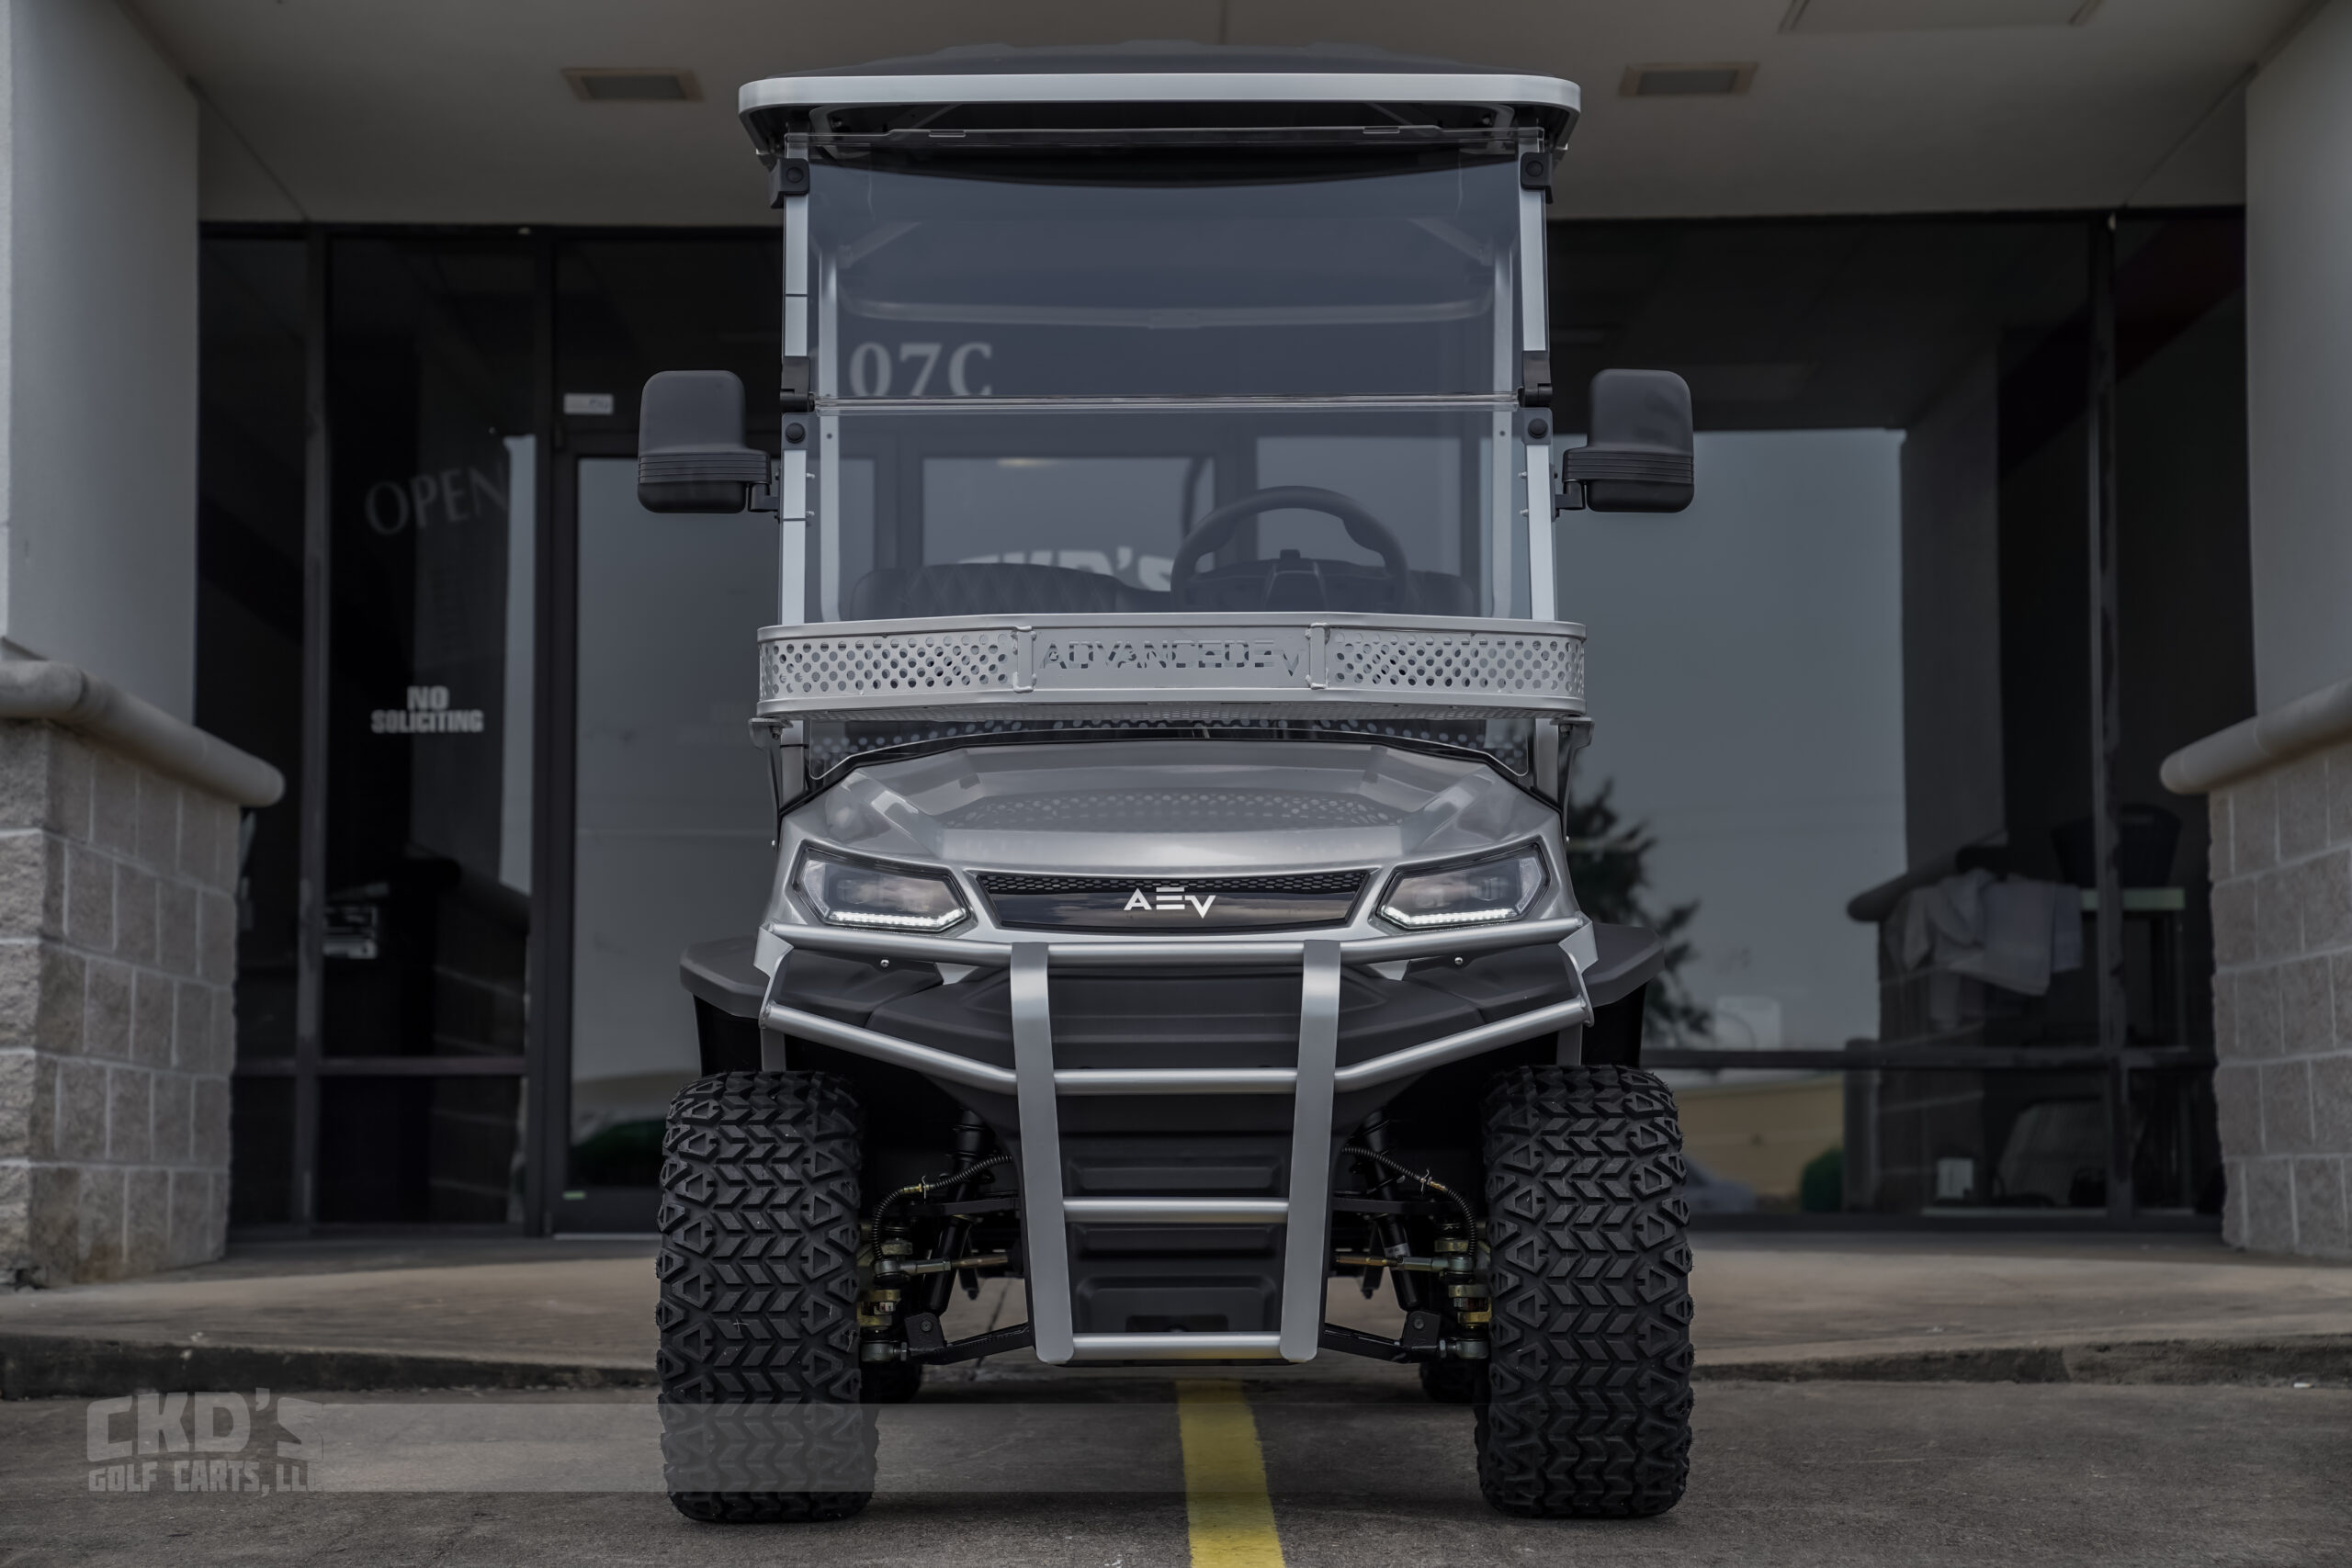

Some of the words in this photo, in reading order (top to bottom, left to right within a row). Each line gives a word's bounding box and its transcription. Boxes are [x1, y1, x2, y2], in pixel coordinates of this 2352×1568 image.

[809, 341, 993, 396] 07C
[365, 461, 511, 536] OPEN
[406, 685, 450, 711] NO
[370, 708, 485, 734] SOLICITING
[1123, 886, 1216, 919] AEV
